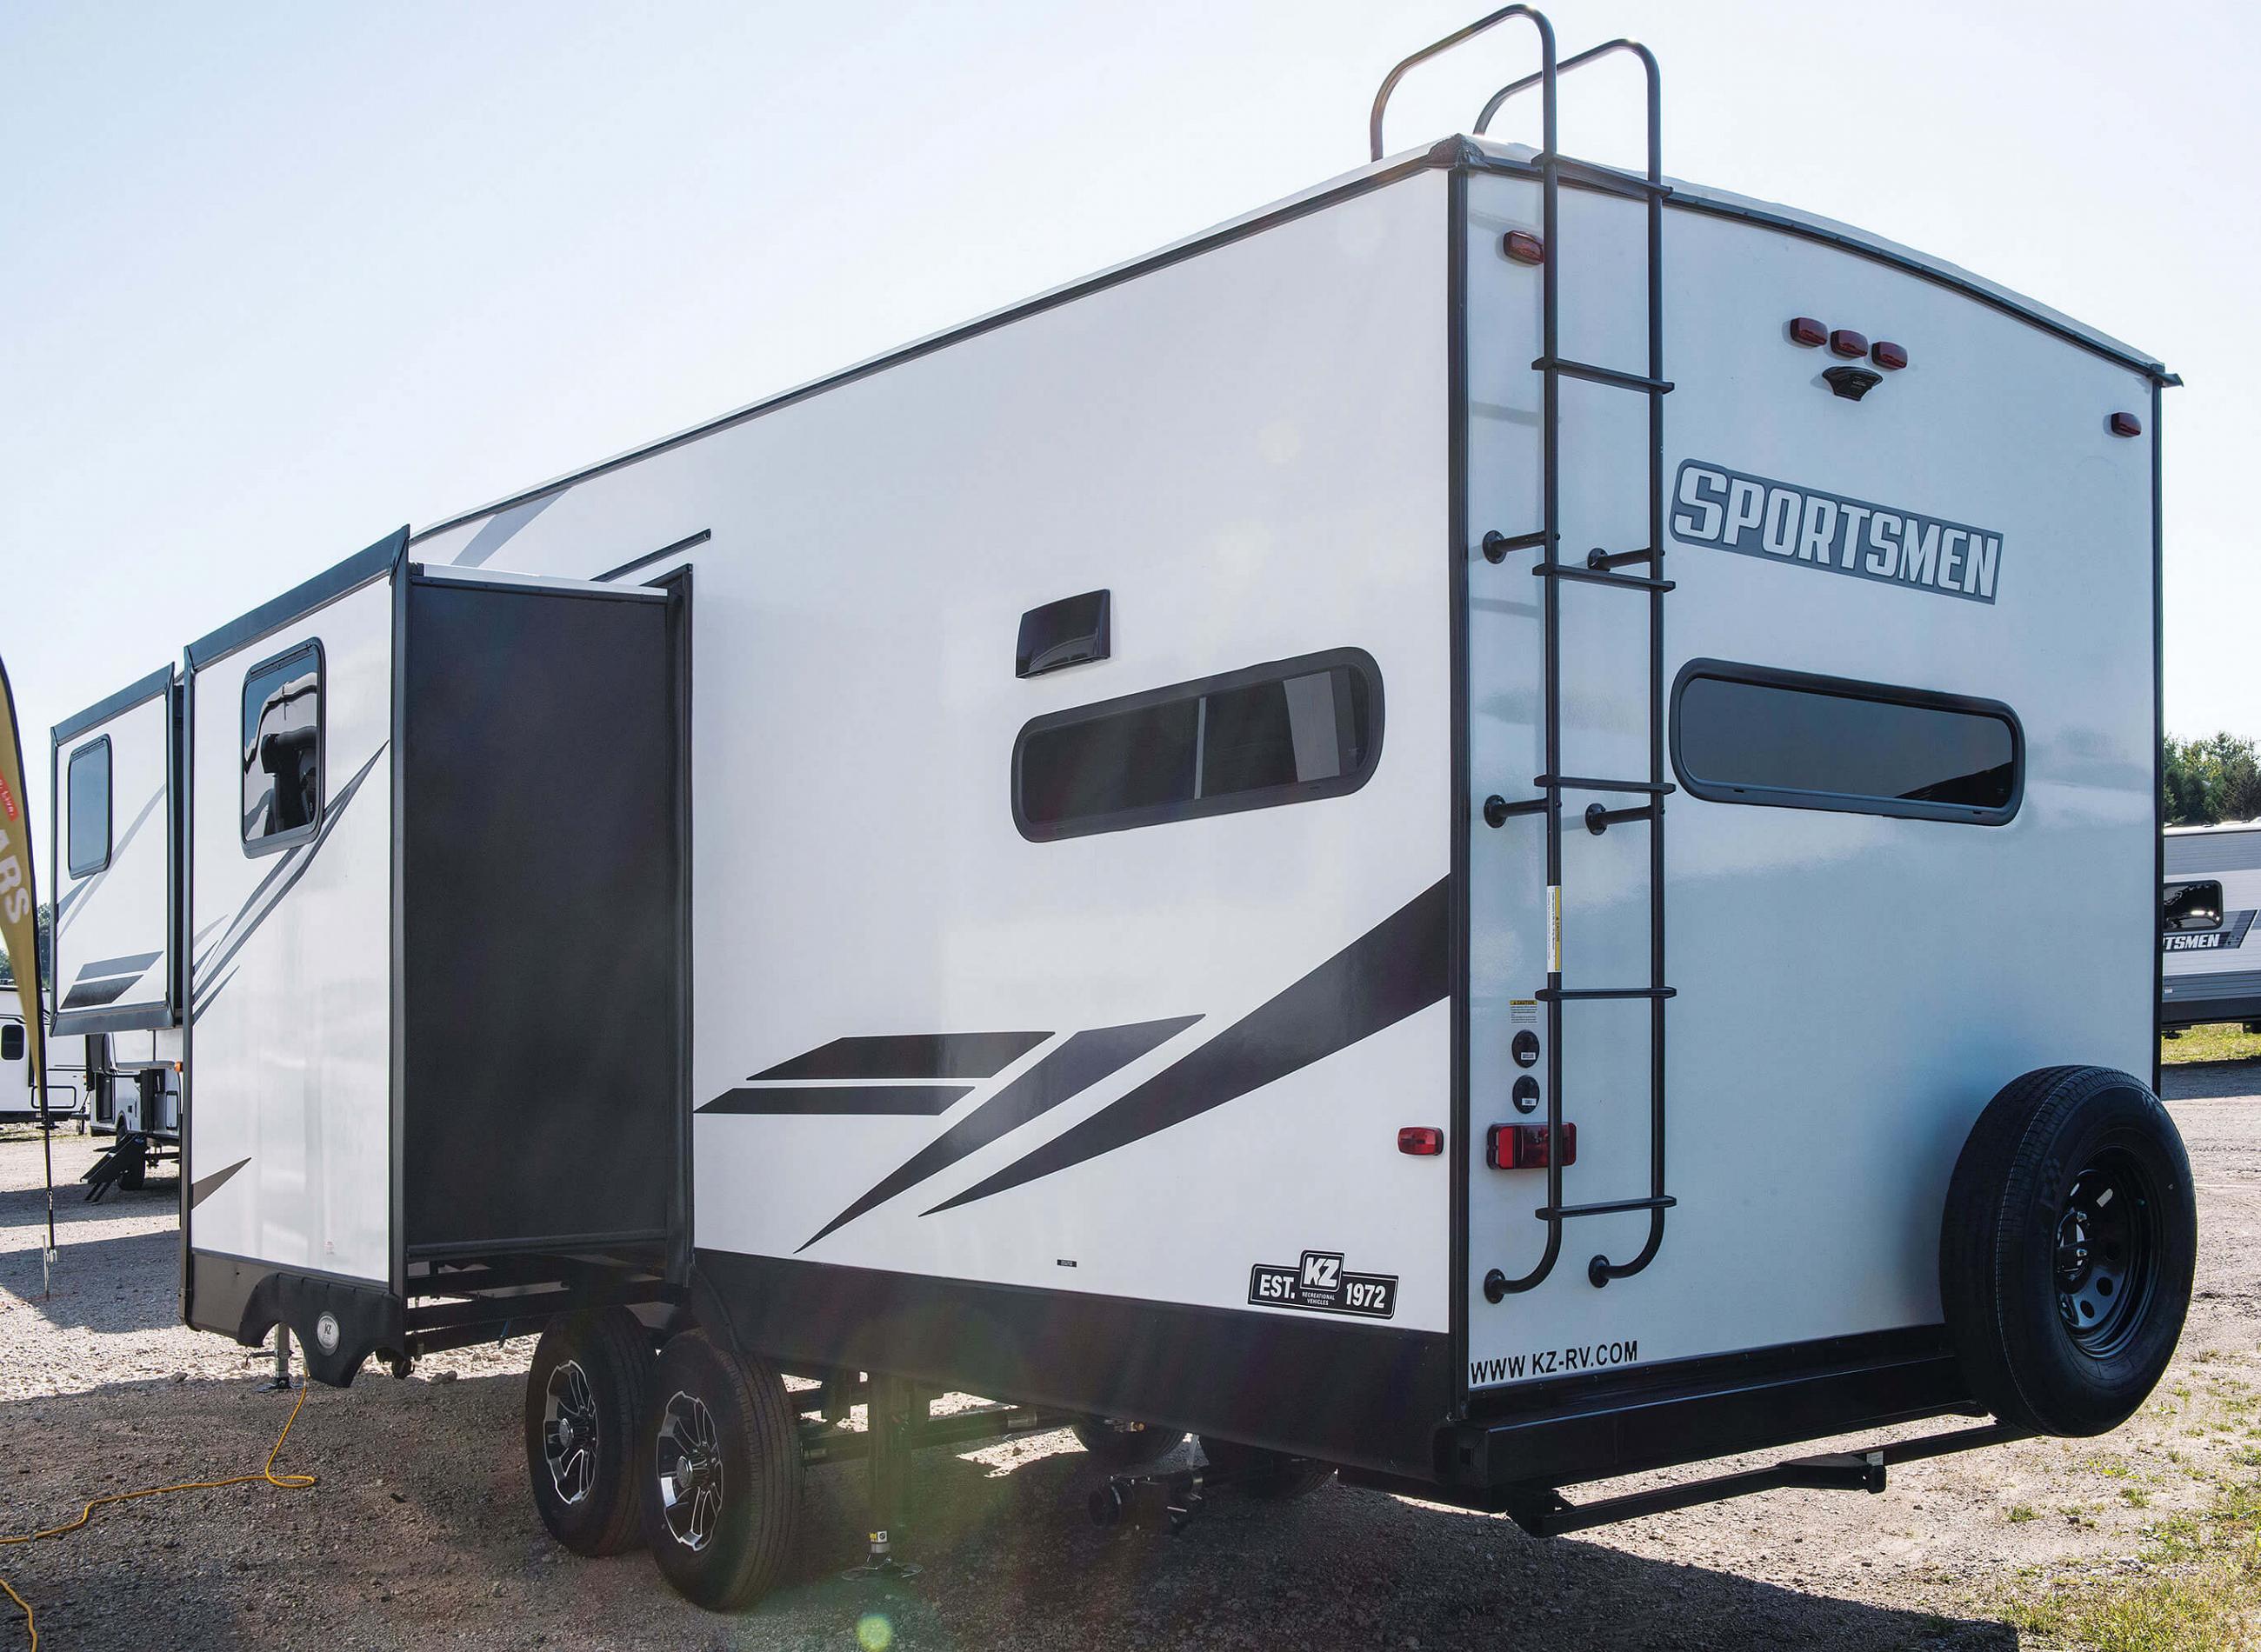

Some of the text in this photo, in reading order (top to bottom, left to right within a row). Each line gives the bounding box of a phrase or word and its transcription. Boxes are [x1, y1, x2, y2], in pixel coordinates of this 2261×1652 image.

[1673, 466, 1999, 597] SPORTSMEN
[2163, 933, 2220, 950] TSMEN
[1303, 1256, 1340, 1288] KZ
[1259, 1274, 1386, 1309] EST. 1972
[1302, 1291, 1335, 1301] RECREATIONAL
[1471, 1340, 1637, 1384] WWW KZ-RV.COM
